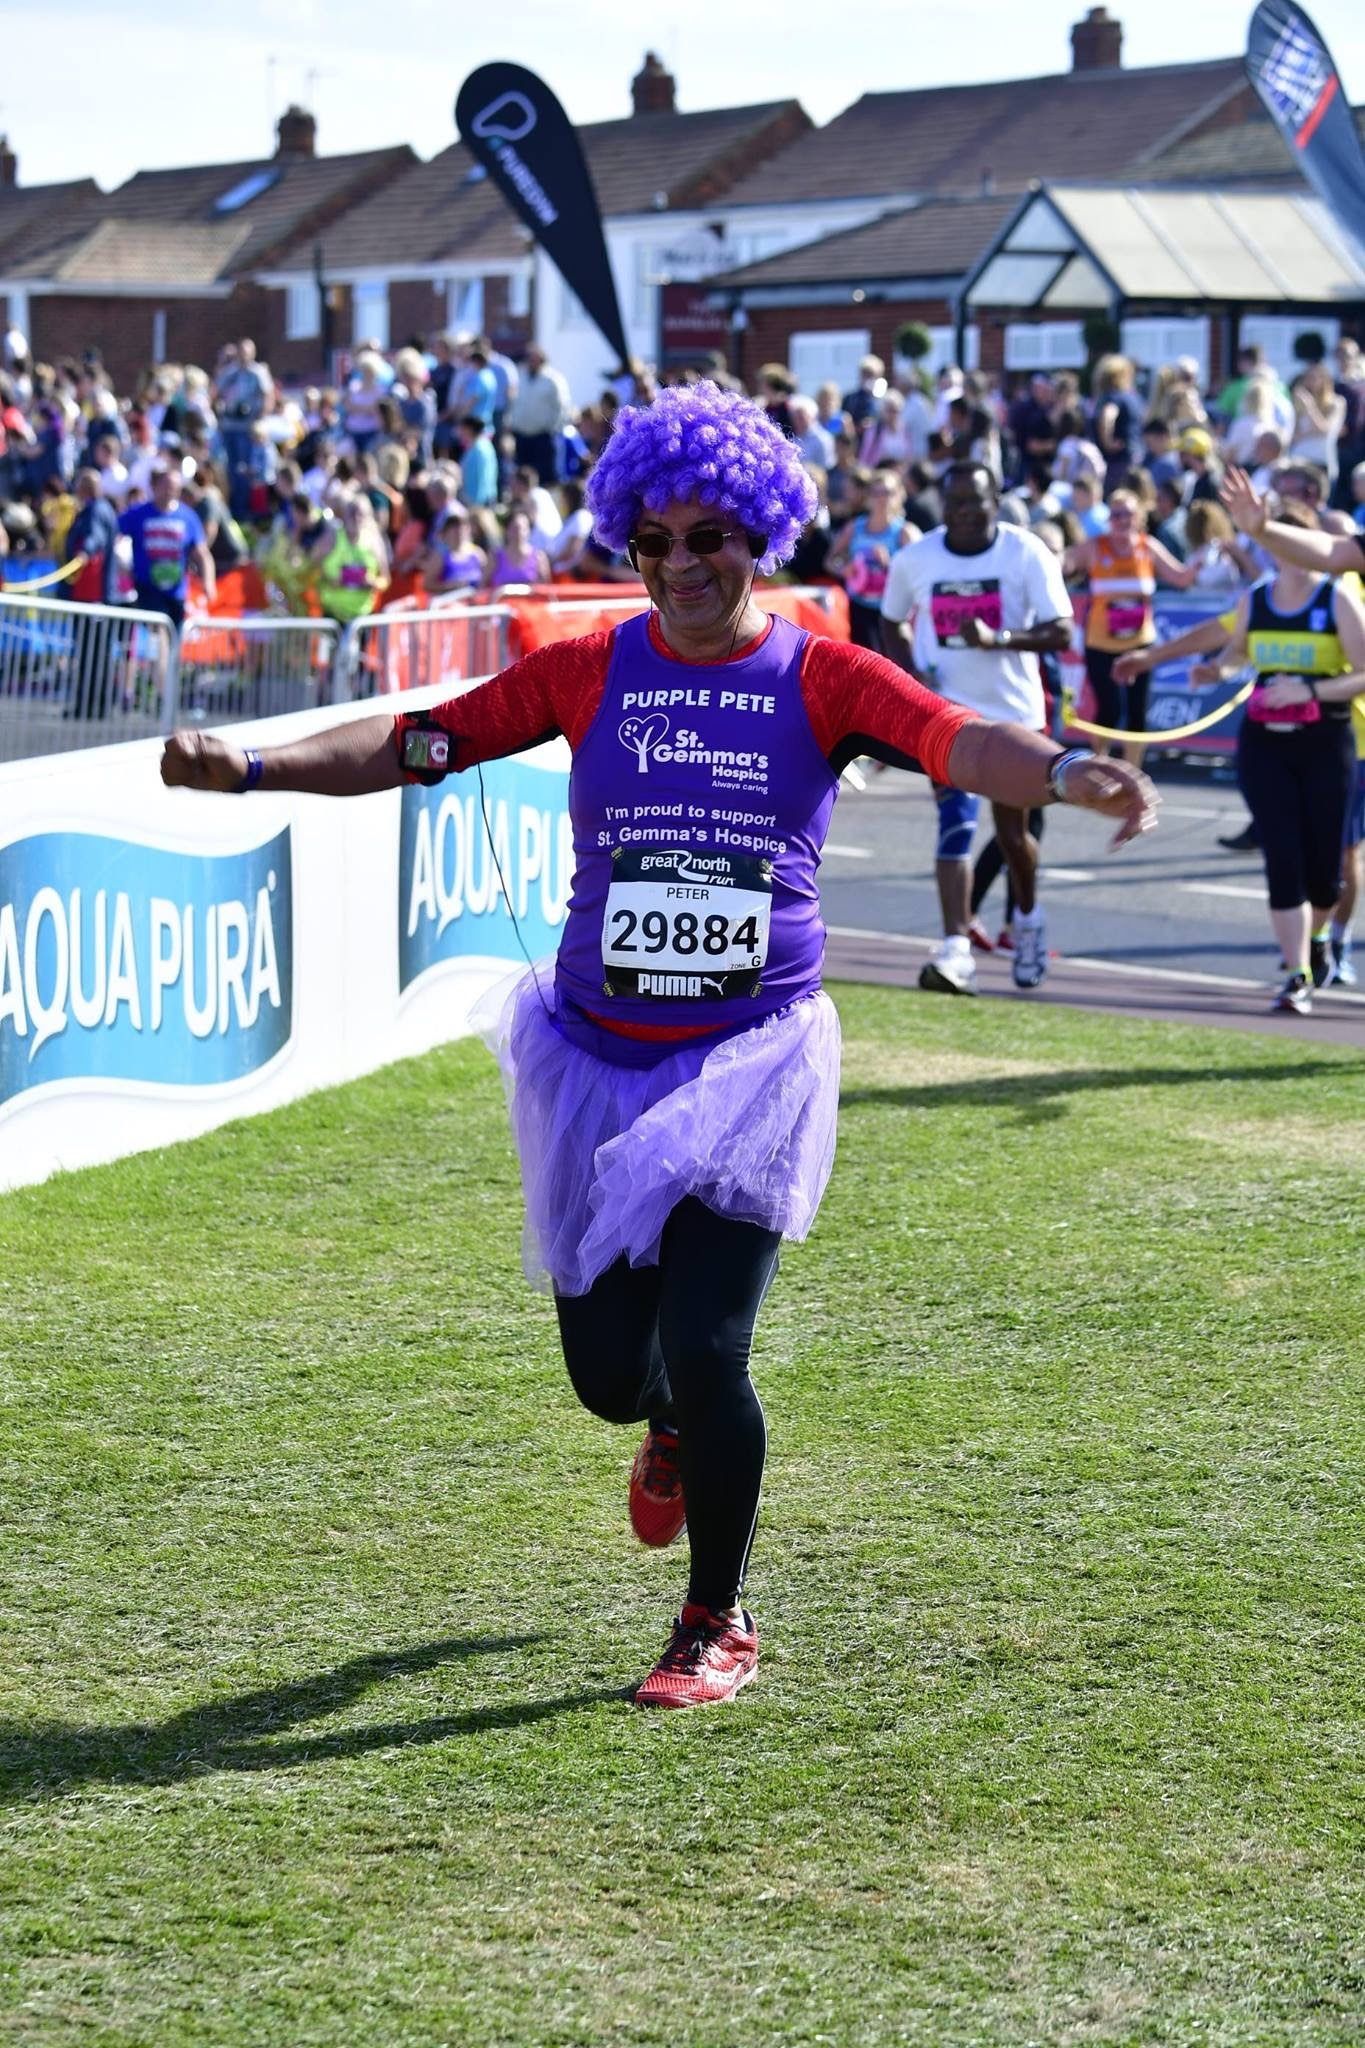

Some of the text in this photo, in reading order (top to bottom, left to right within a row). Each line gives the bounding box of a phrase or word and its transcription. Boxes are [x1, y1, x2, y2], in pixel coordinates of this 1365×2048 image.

[622, 689, 776, 714] PURPLE PETE
[674, 729, 704, 749] St.
[653, 743, 769, 769] Gemma's
[711, 765, 768, 782] Hospice
[711, 780, 769, 795] Always caring
[605, 803, 777, 828] I'm proud to support
[597, 826, 787, 854] St. Gemma's Hospice
[407, 792, 513, 941] AQUA
[640, 854, 731, 873] great north
[708, 873, 735, 887] run
[666, 887, 710, 901] PETER
[610, 909, 760, 956] 29884
[730, 955, 761, 970] ZONE G
[0, 886, 281, 1064] AQUA PURA
[637, 973, 702, 997] PUMA
